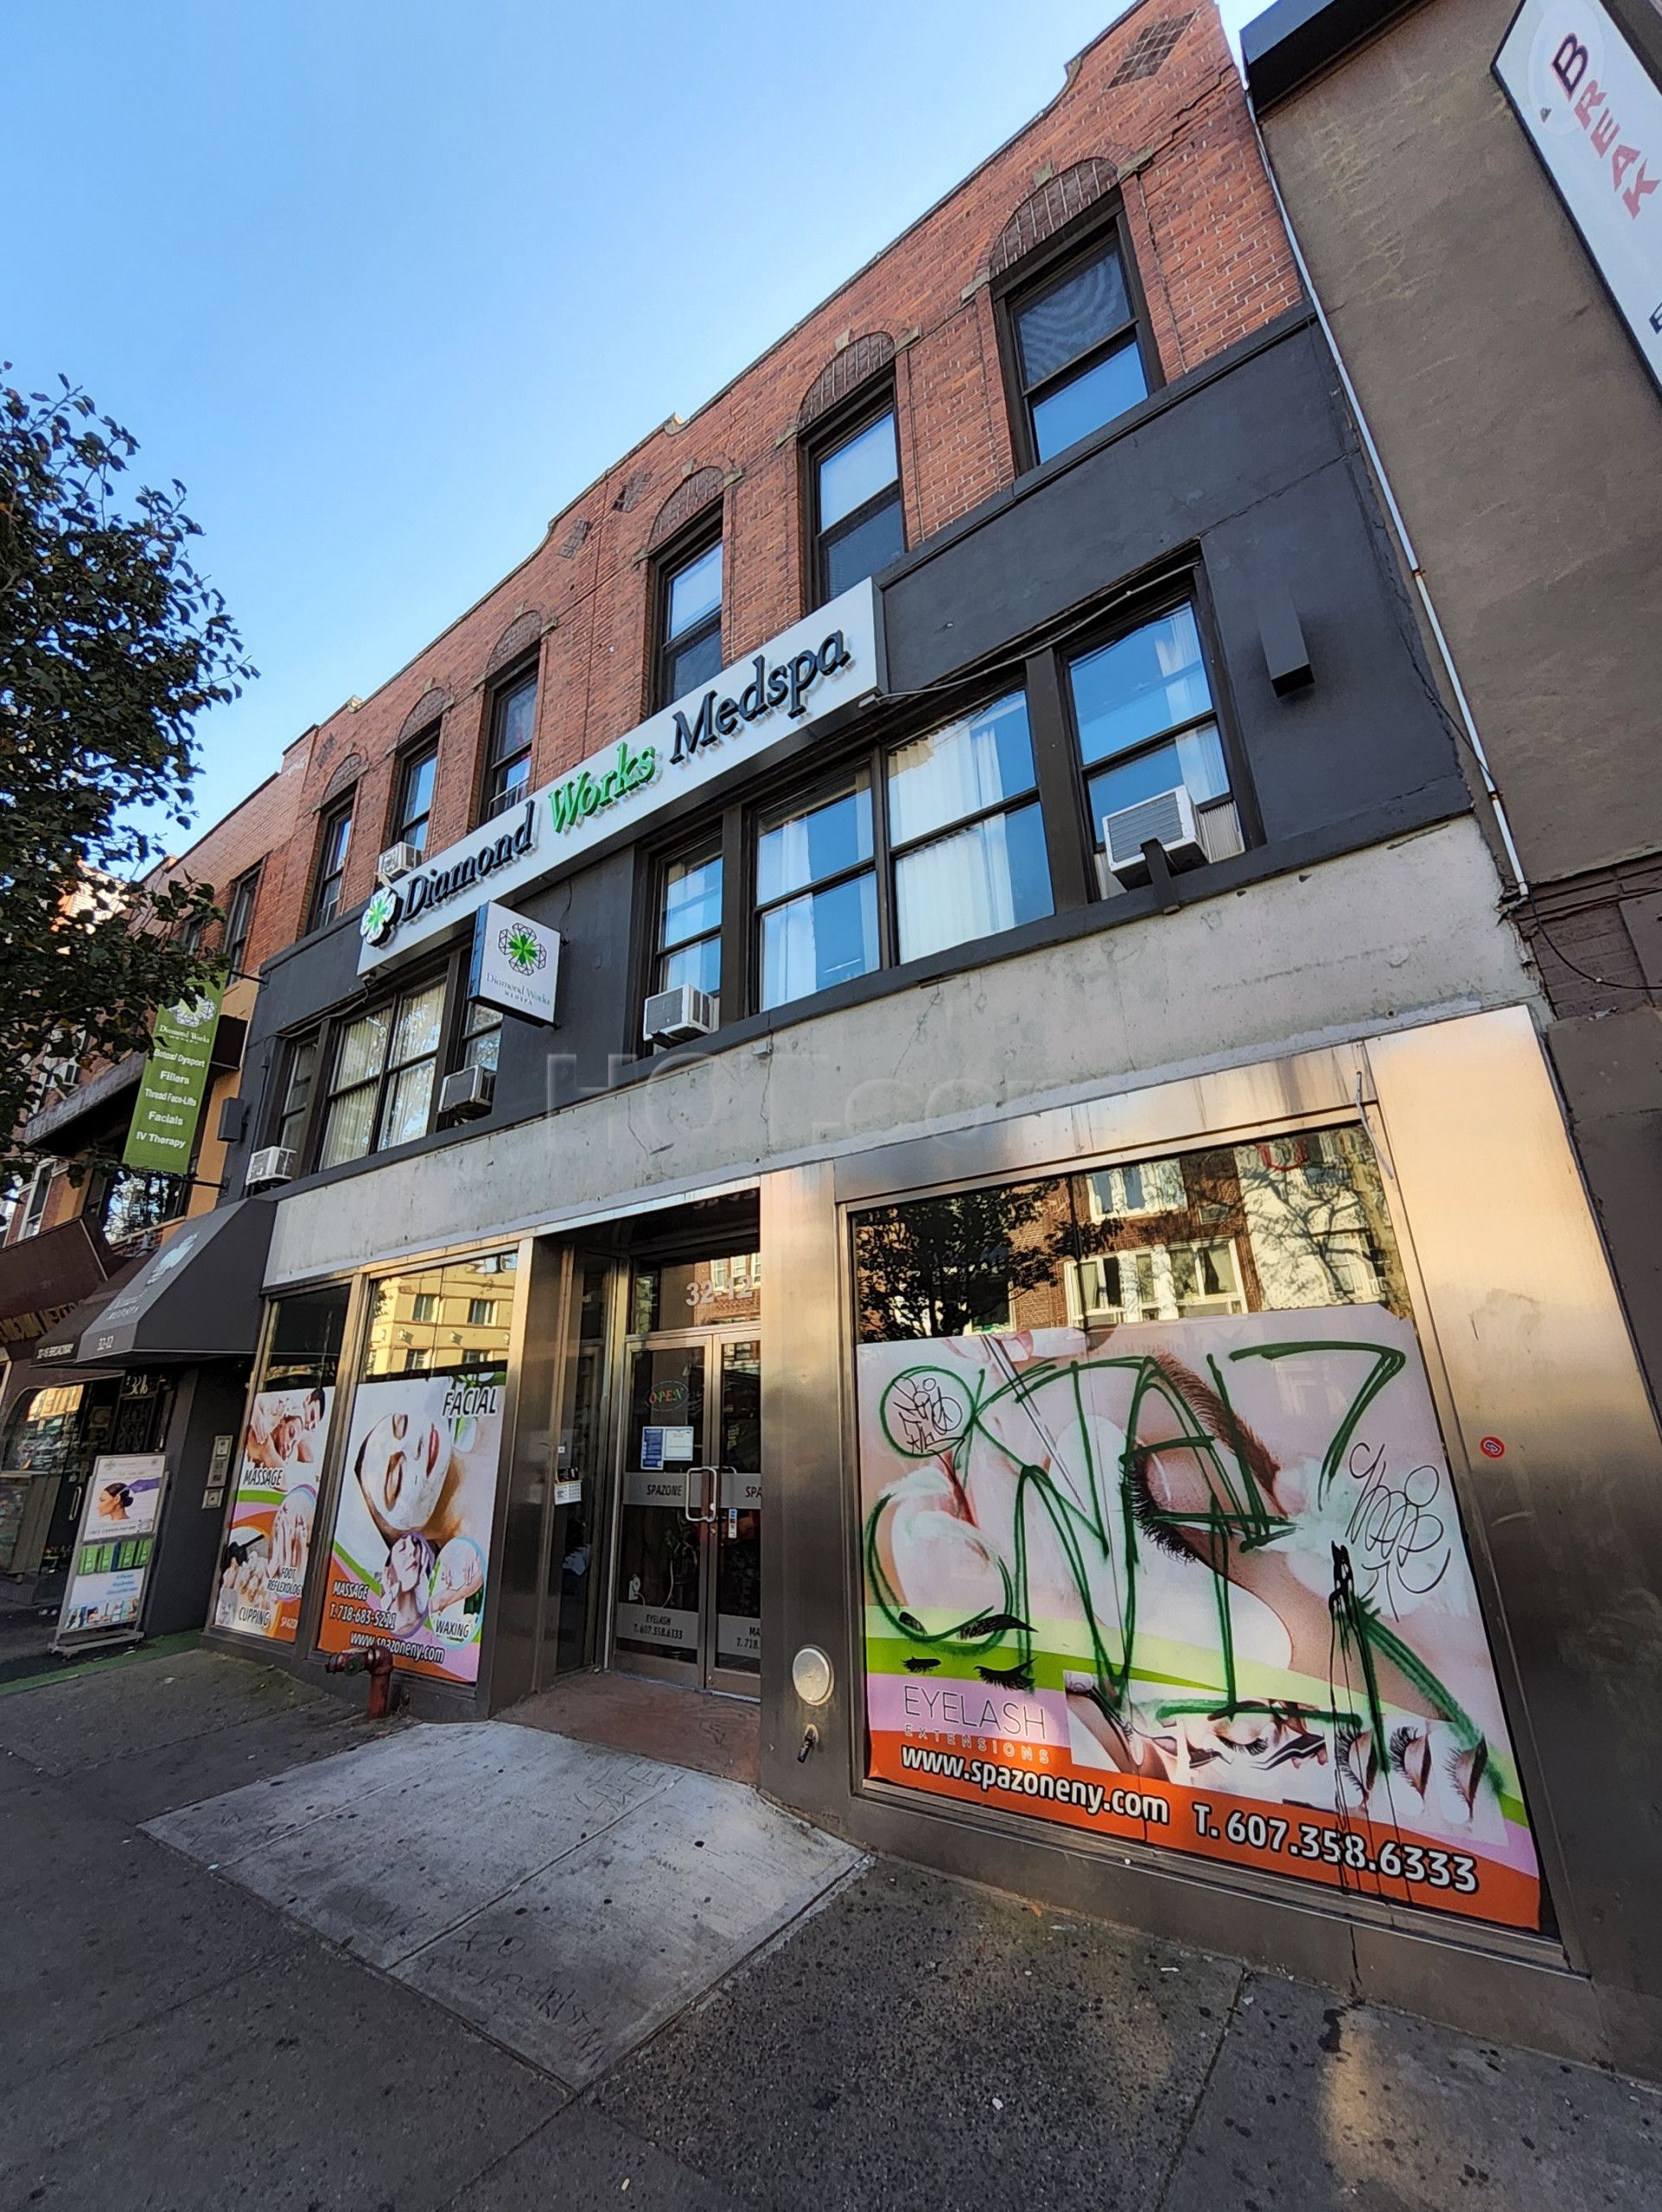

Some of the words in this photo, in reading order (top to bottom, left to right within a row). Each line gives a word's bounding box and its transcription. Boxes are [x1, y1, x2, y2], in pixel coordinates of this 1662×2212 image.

[1552, 32, 1660, 219] BREAK
[402, 800, 534, 922] Diamond
[548, 742, 655, 833] Works
[670, 630, 850, 764] Medspa
[486, 972, 525, 995] Diamond
[160, 1070, 190, 1084] Fillers
[148, 1110, 183, 1126] Facials
[136, 1130, 148, 1141] IV
[149, 1133, 187, 1149] Therapy
[685, 1274, 753, 1306] 32-12
[443, 1387, 497, 1417] FACIAL
[649, 1387, 683, 1405] OPEN
[243, 1469, 283, 1486] MASSAGE
[646, 1484, 682, 1497] SPAZONE
[282, 1567, 296, 1580] FOOT
[332, 1580, 370, 1601] MASSAGE
[239, 1606, 271, 1626] CUPPING
[646, 1614, 672, 1625] EYELASH
[436, 1618, 470, 1638] WAXING
[904, 1685, 1046, 1740] EYELASH
[904, 1724, 1050, 1764] EXTENSIONS
[901, 1744, 1169, 1824] www.spazoneny.com
[1193, 1803, 1219, 1840] T.
[1226, 1812, 1479, 1893] 607.358.6333
